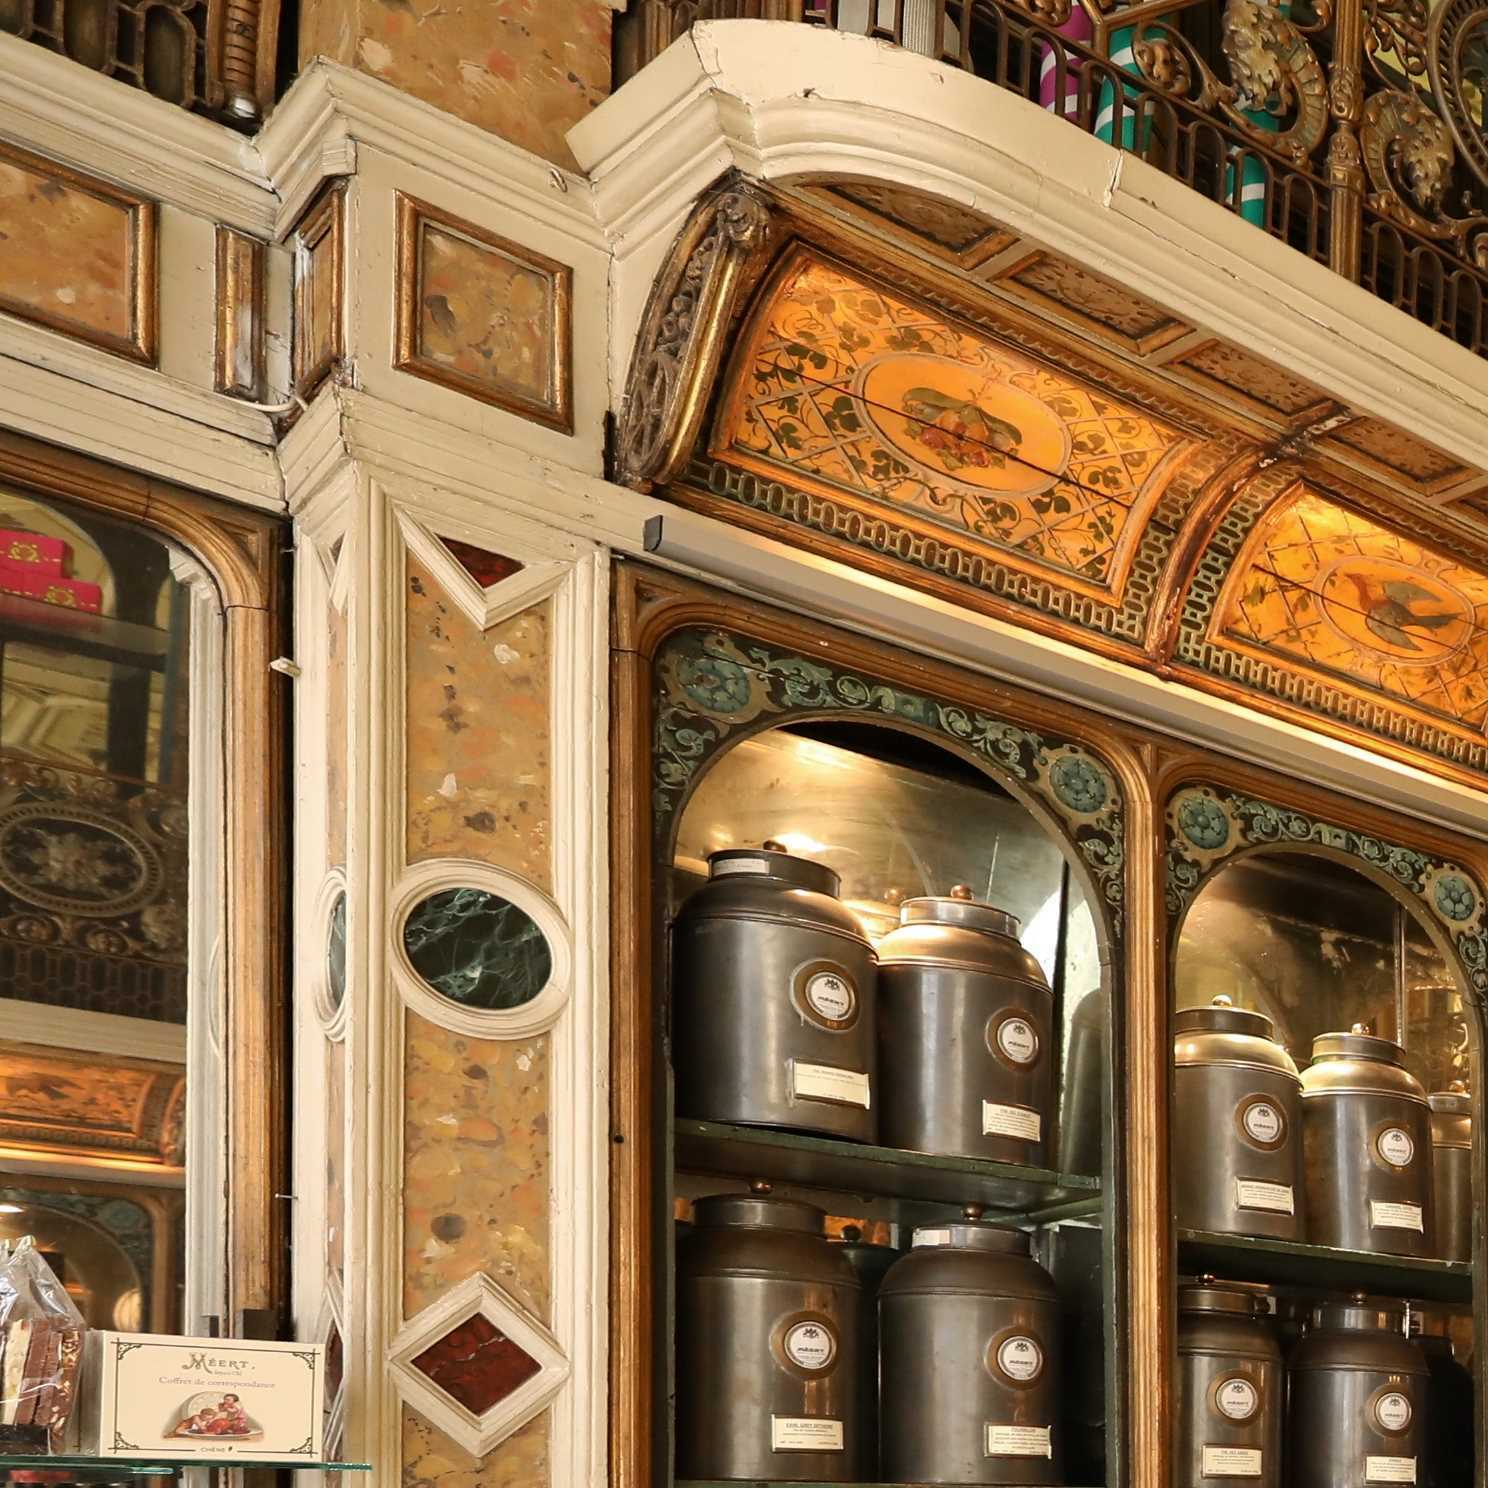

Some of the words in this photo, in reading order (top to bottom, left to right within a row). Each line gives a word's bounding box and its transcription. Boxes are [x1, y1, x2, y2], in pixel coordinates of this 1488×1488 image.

[159, 1376, 192, 1386] Coffret
[194, 1378, 205, 1386] de
[207, 1379, 276, 1389] correspondance
